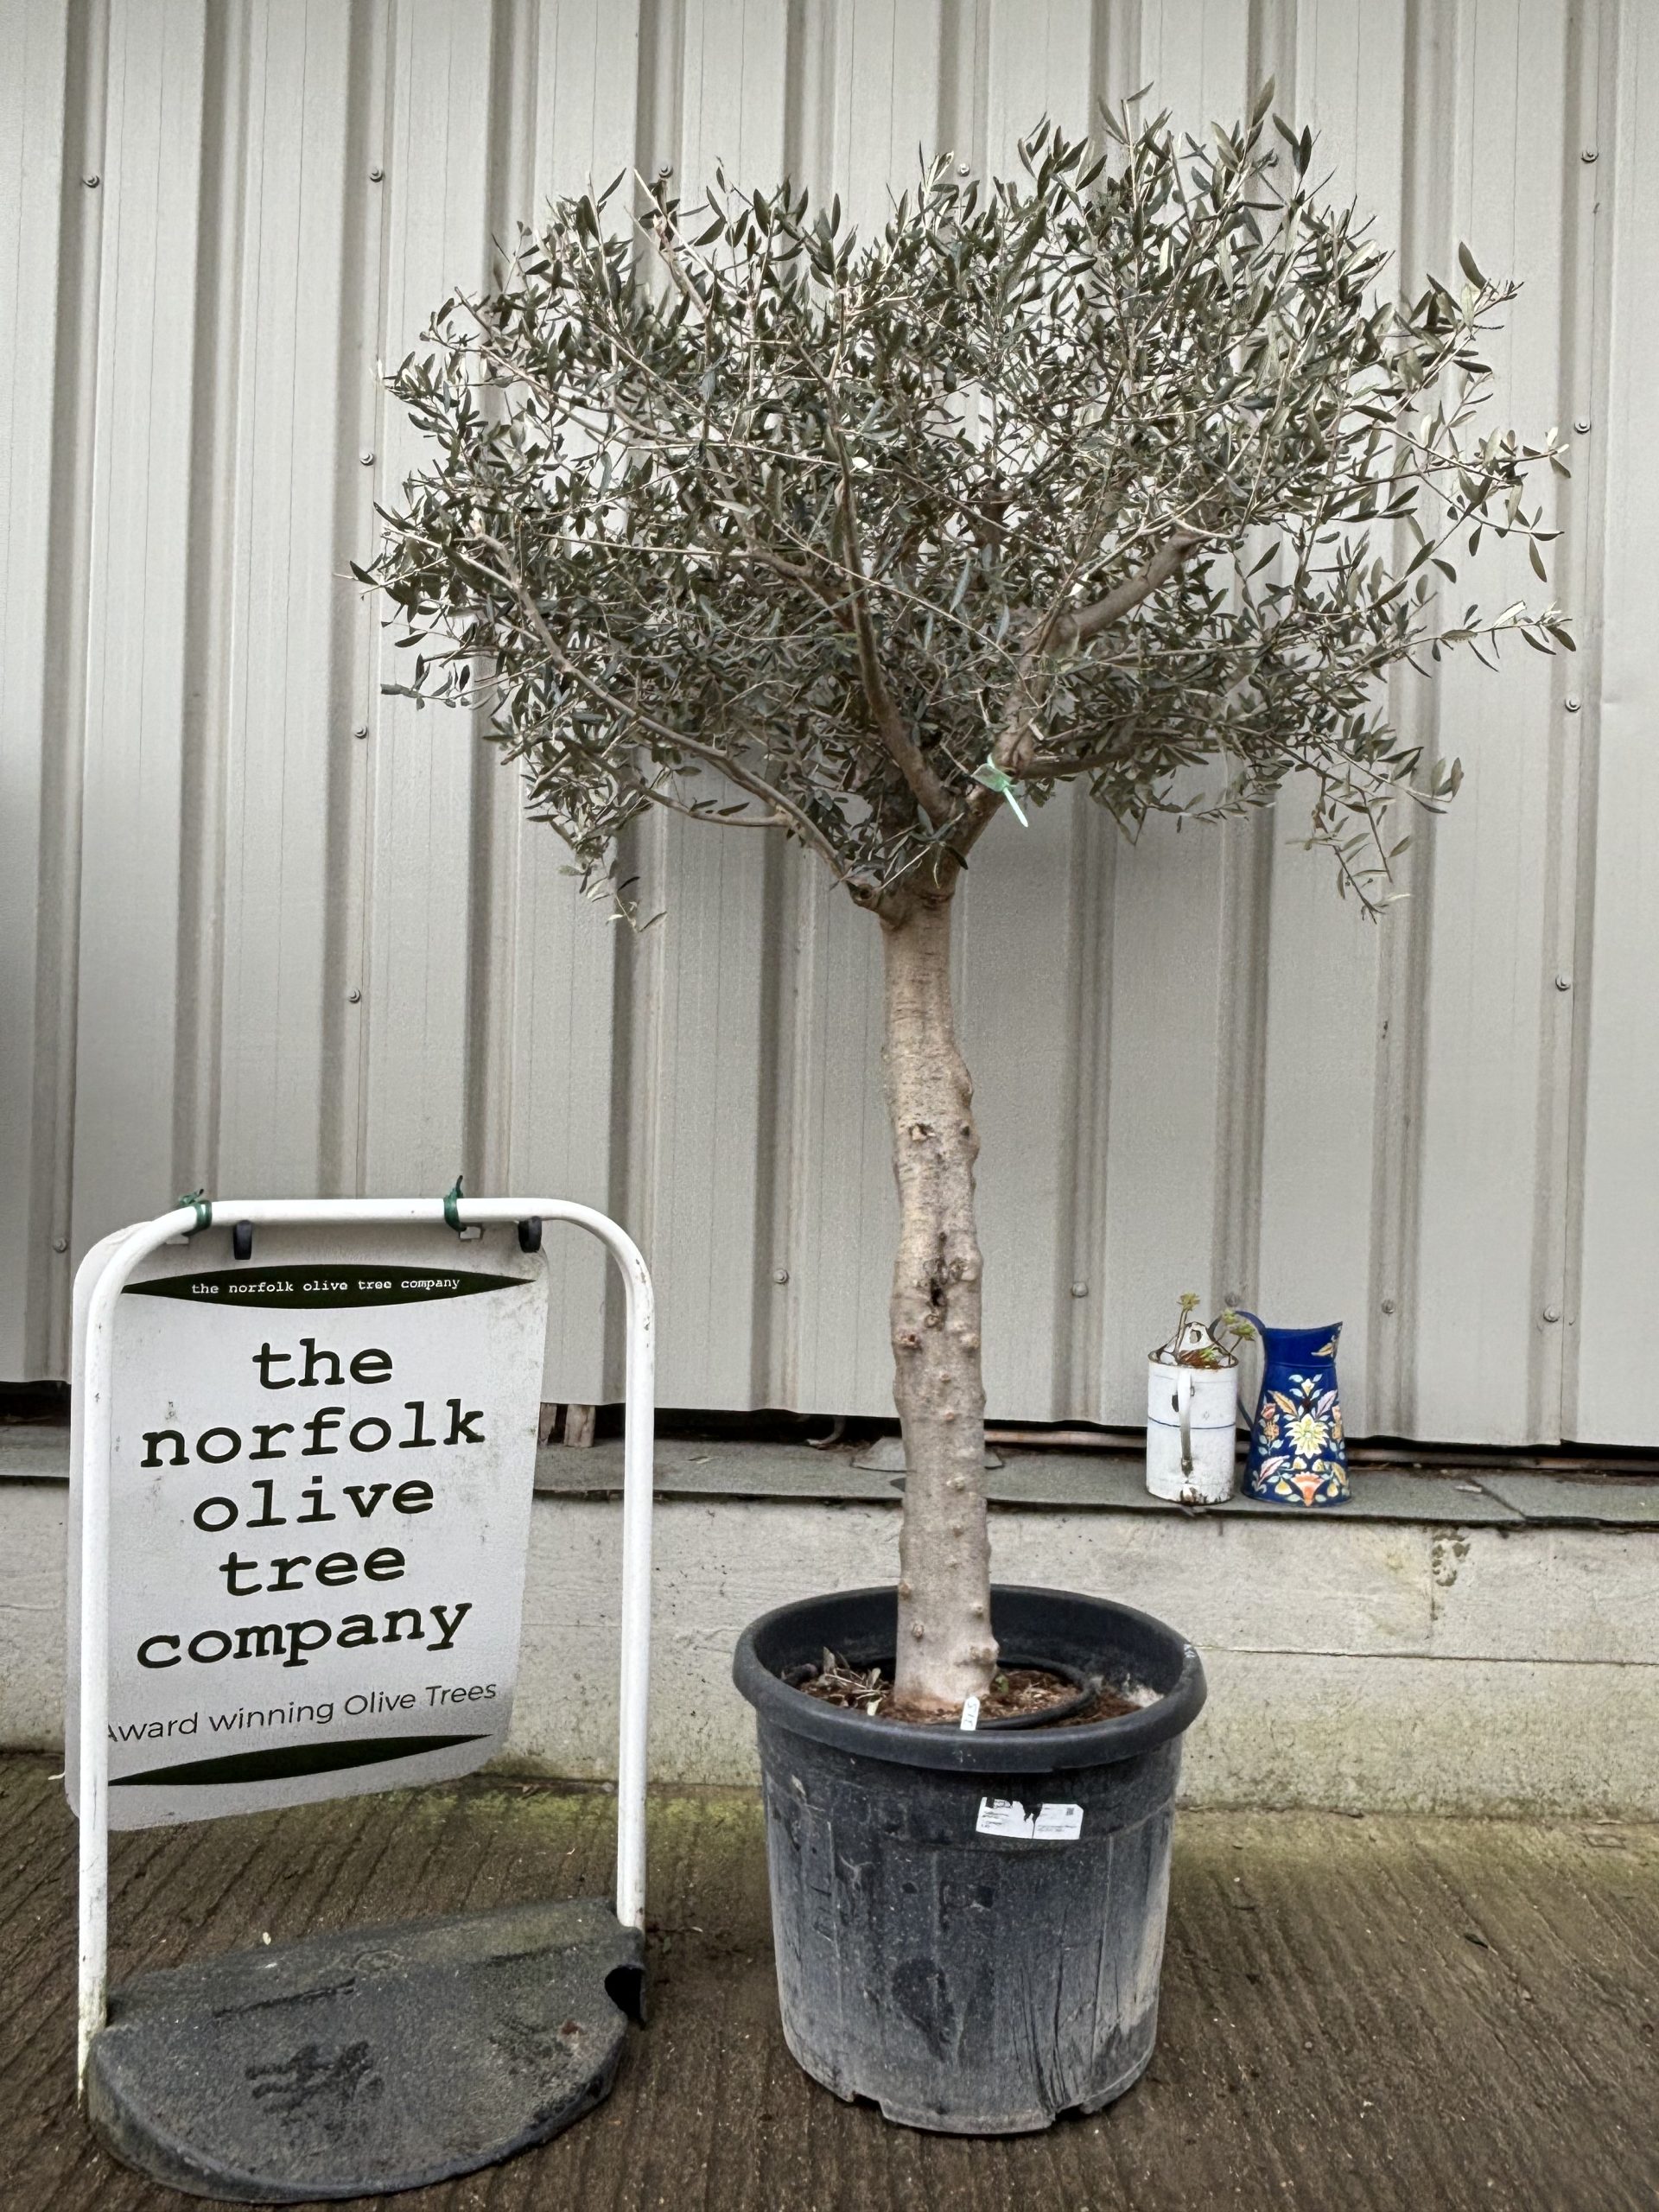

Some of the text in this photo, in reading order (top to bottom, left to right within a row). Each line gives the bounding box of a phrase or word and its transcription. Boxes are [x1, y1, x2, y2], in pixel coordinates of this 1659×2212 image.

[192, 1278, 461, 1294] the norfolk olive tree company
[251, 1338, 393, 1390] the
[140, 1398, 486, 1468] norfolk
[193, 1475, 434, 1533] olive
[219, 1547, 405, 1597] tree
[137, 1602, 473, 1669] company
[208, 1700, 334, 1732] winning
[344, 1691, 416, 1716] Olive
[425, 1683, 497, 1707] Trees
